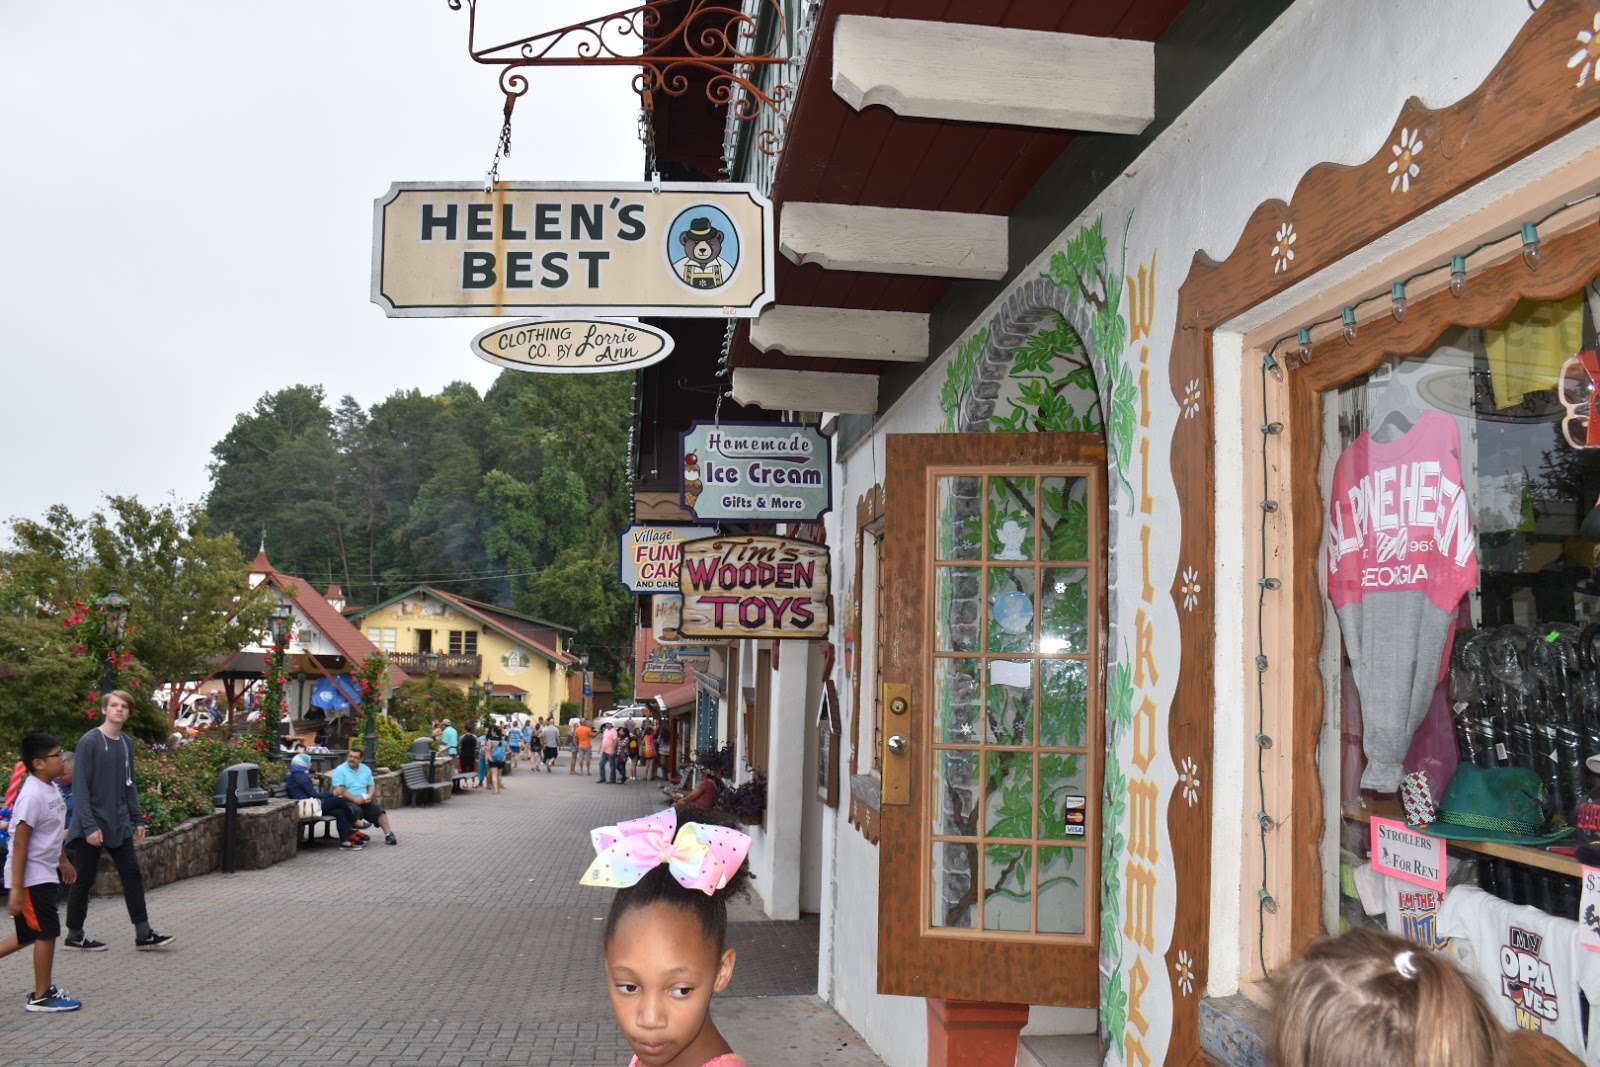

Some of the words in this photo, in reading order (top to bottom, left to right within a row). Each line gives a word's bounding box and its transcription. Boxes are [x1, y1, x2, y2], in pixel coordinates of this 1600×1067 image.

[421, 197, 646, 241] HELEN'S
[462, 251, 610, 289] BEST
[499, 327, 572, 350] CLOTHING
[575, 324, 637, 357] Lorrie
[528, 343, 551, 359] CO.
[557, 344, 572, 361] BY
[595, 346, 638, 362] Ann
[708, 433, 811, 454] Homemade
[706, 462, 739, 483] Ice
[748, 463, 822, 485] Cream
[722, 496, 752, 509] Gifts
[756, 497, 767, 509] &
[771, 498, 802, 509] More
[634, 530, 673, 545] Village
[713, 538, 800, 564] Tim's
[686, 556, 815, 591] WOODEN
[697, 595, 815, 630] TOYS
[1379, 825, 1432, 850] STROLLERS
[1393, 854, 1412, 872] FOR
[1413, 859, 1440, 880] RENT
[1414, 891, 1436, 911] THE
[1510, 926, 1542, 956] MY
[1500, 945, 1557, 999] OPA
[1515, 1004, 1542, 1031] ME
